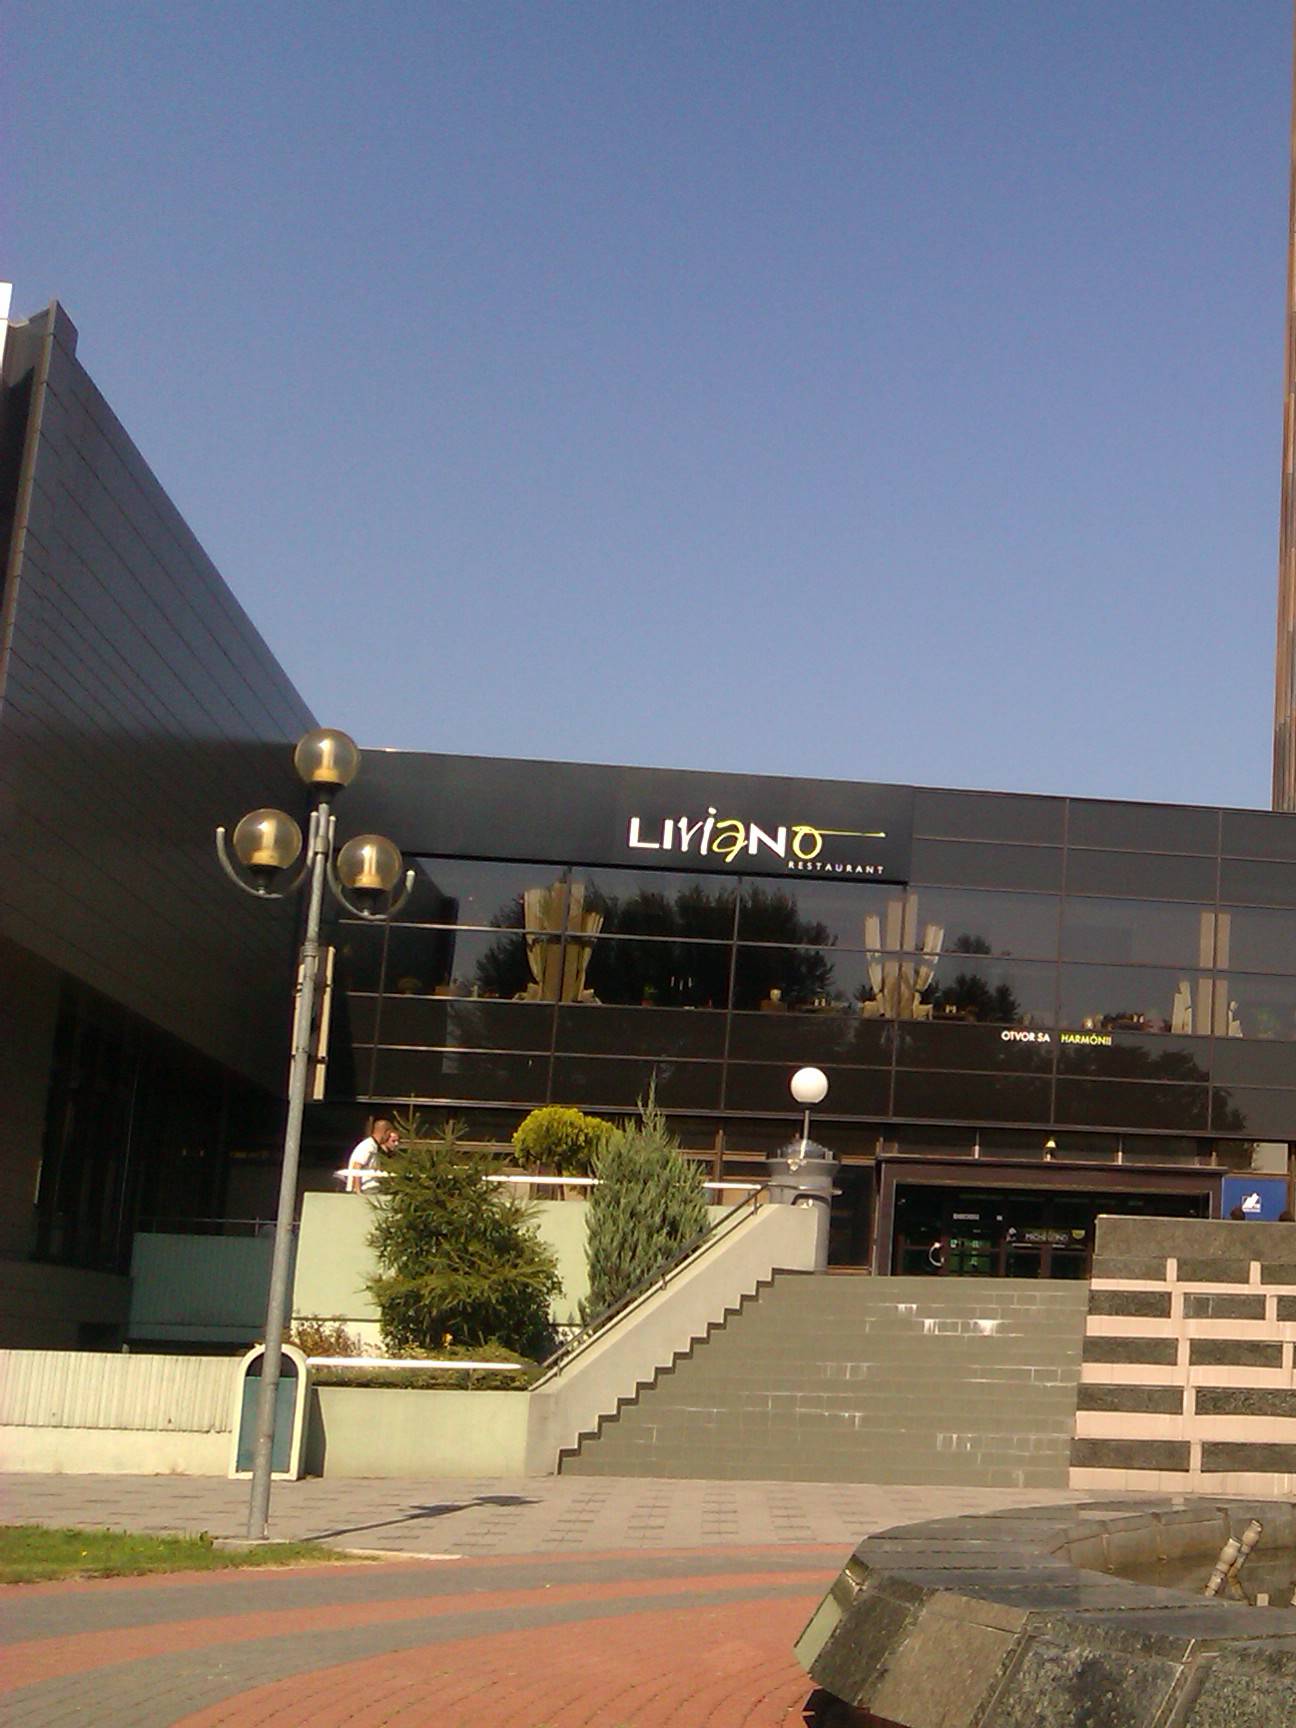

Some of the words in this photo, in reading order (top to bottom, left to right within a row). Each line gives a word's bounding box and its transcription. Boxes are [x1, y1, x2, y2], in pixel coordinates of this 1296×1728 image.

[787, 861, 885, 875] RESTAURANT
[1001, 1030, 1036, 1042] OTVOR
[1037, 1032, 1051, 1043] SA
